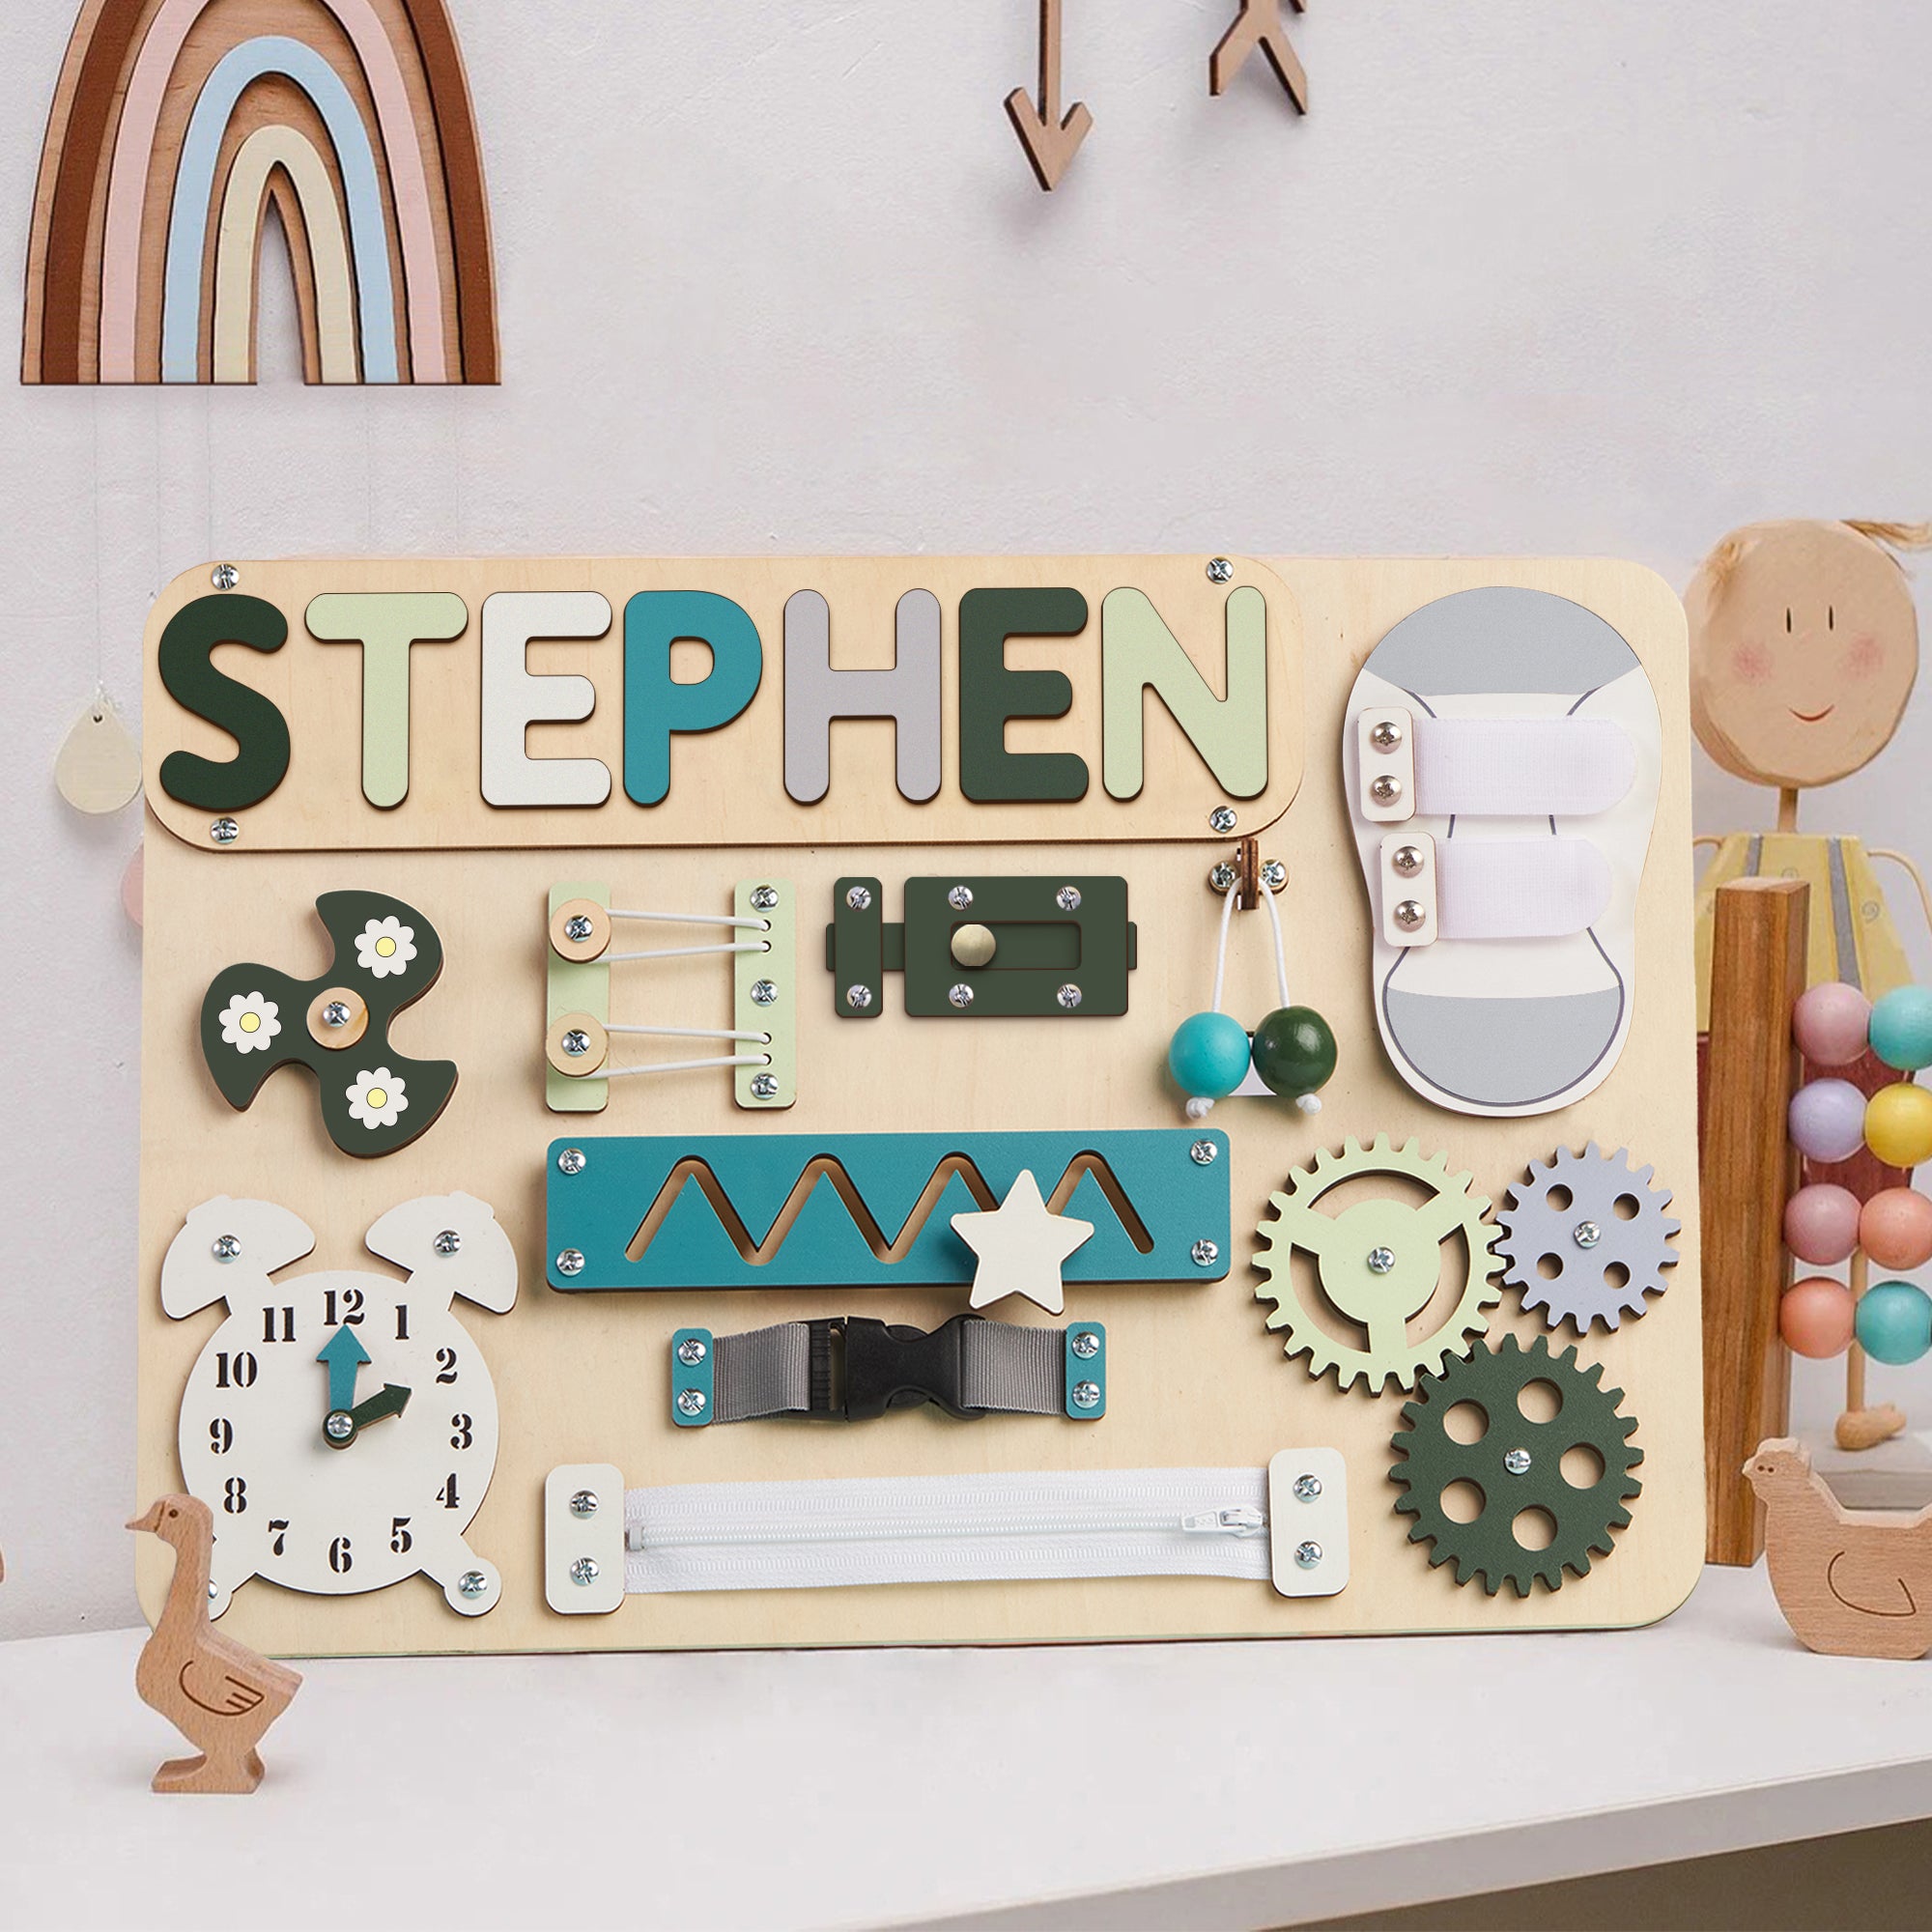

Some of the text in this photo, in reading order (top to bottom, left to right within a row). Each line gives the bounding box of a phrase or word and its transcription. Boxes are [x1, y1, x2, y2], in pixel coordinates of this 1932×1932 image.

[158, 585, 1268, 810] STEPHEN
[262, 1306, 296, 1343] 11
[324, 1289, 365, 1325] 12
[395, 1304, 410, 1340] 1
[215, 1351, 258, 1388] 10
[436, 1348, 458, 1384] 2
[210, 1418, 233, 1455] 9
[450, 1413, 472, 1450] 3
[223, 1477, 247, 1514] 8
[436, 1473, 460, 1509] 4
[268, 1520, 290, 1556] 7
[390, 1517, 412, 1553] 5
[328, 1537, 353, 1574] 6
